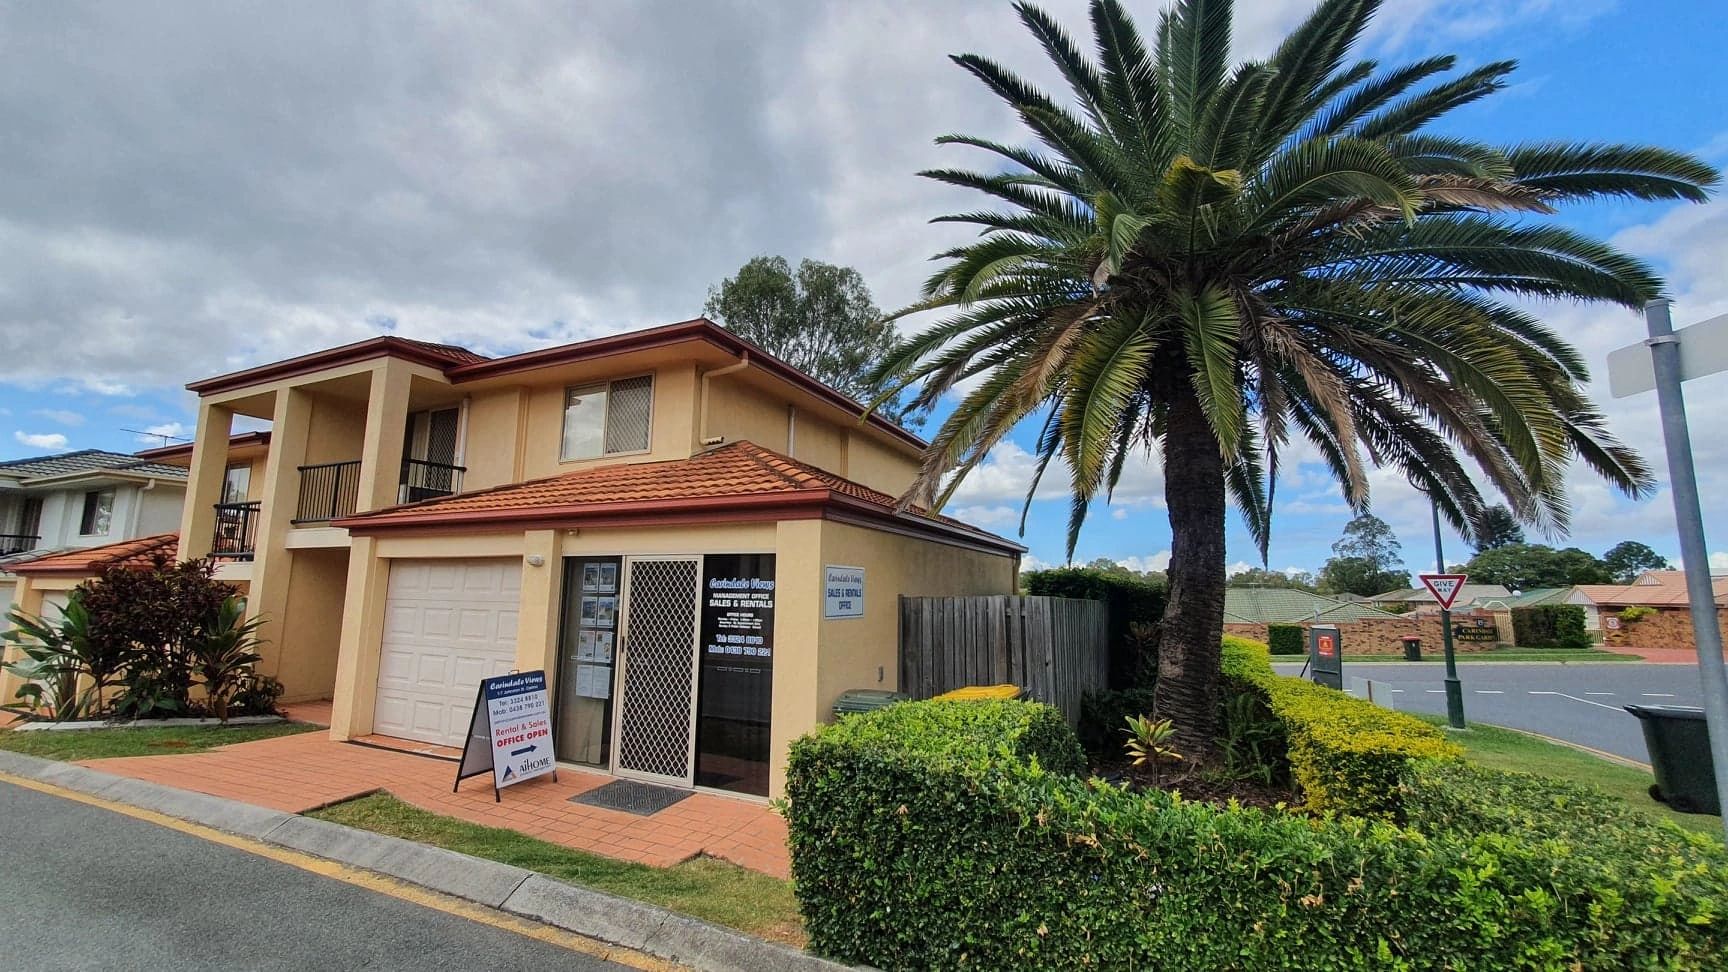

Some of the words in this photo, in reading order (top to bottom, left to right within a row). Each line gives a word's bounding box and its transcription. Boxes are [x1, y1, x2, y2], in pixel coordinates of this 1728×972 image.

[709, 577, 749, 589] Carindale
[750, 578, 775, 590] Views
[828, 588, 840, 597] SALES
[841, 588, 845, 597] &
[845, 588, 862, 597] RENTALS
[709, 599, 731, 607] SALES
[740, 600, 773, 608] RENTALS
[839, 600, 852, 610] OFFICE
[757, 647, 771, 656] 221
[490, 678, 524, 690] Carindale
[525, 676, 543, 684] Views
[509, 705, 523, 713] 0438
[524, 702, 534, 710] 790
[535, 700, 545, 708] 221
[510, 697, 524, 705] 3324
[495, 724, 519, 737] Rental
[528, 720, 547, 729] Sales
[496, 735, 525, 748] OFFICE
[527, 728, 548, 740] OPEN
